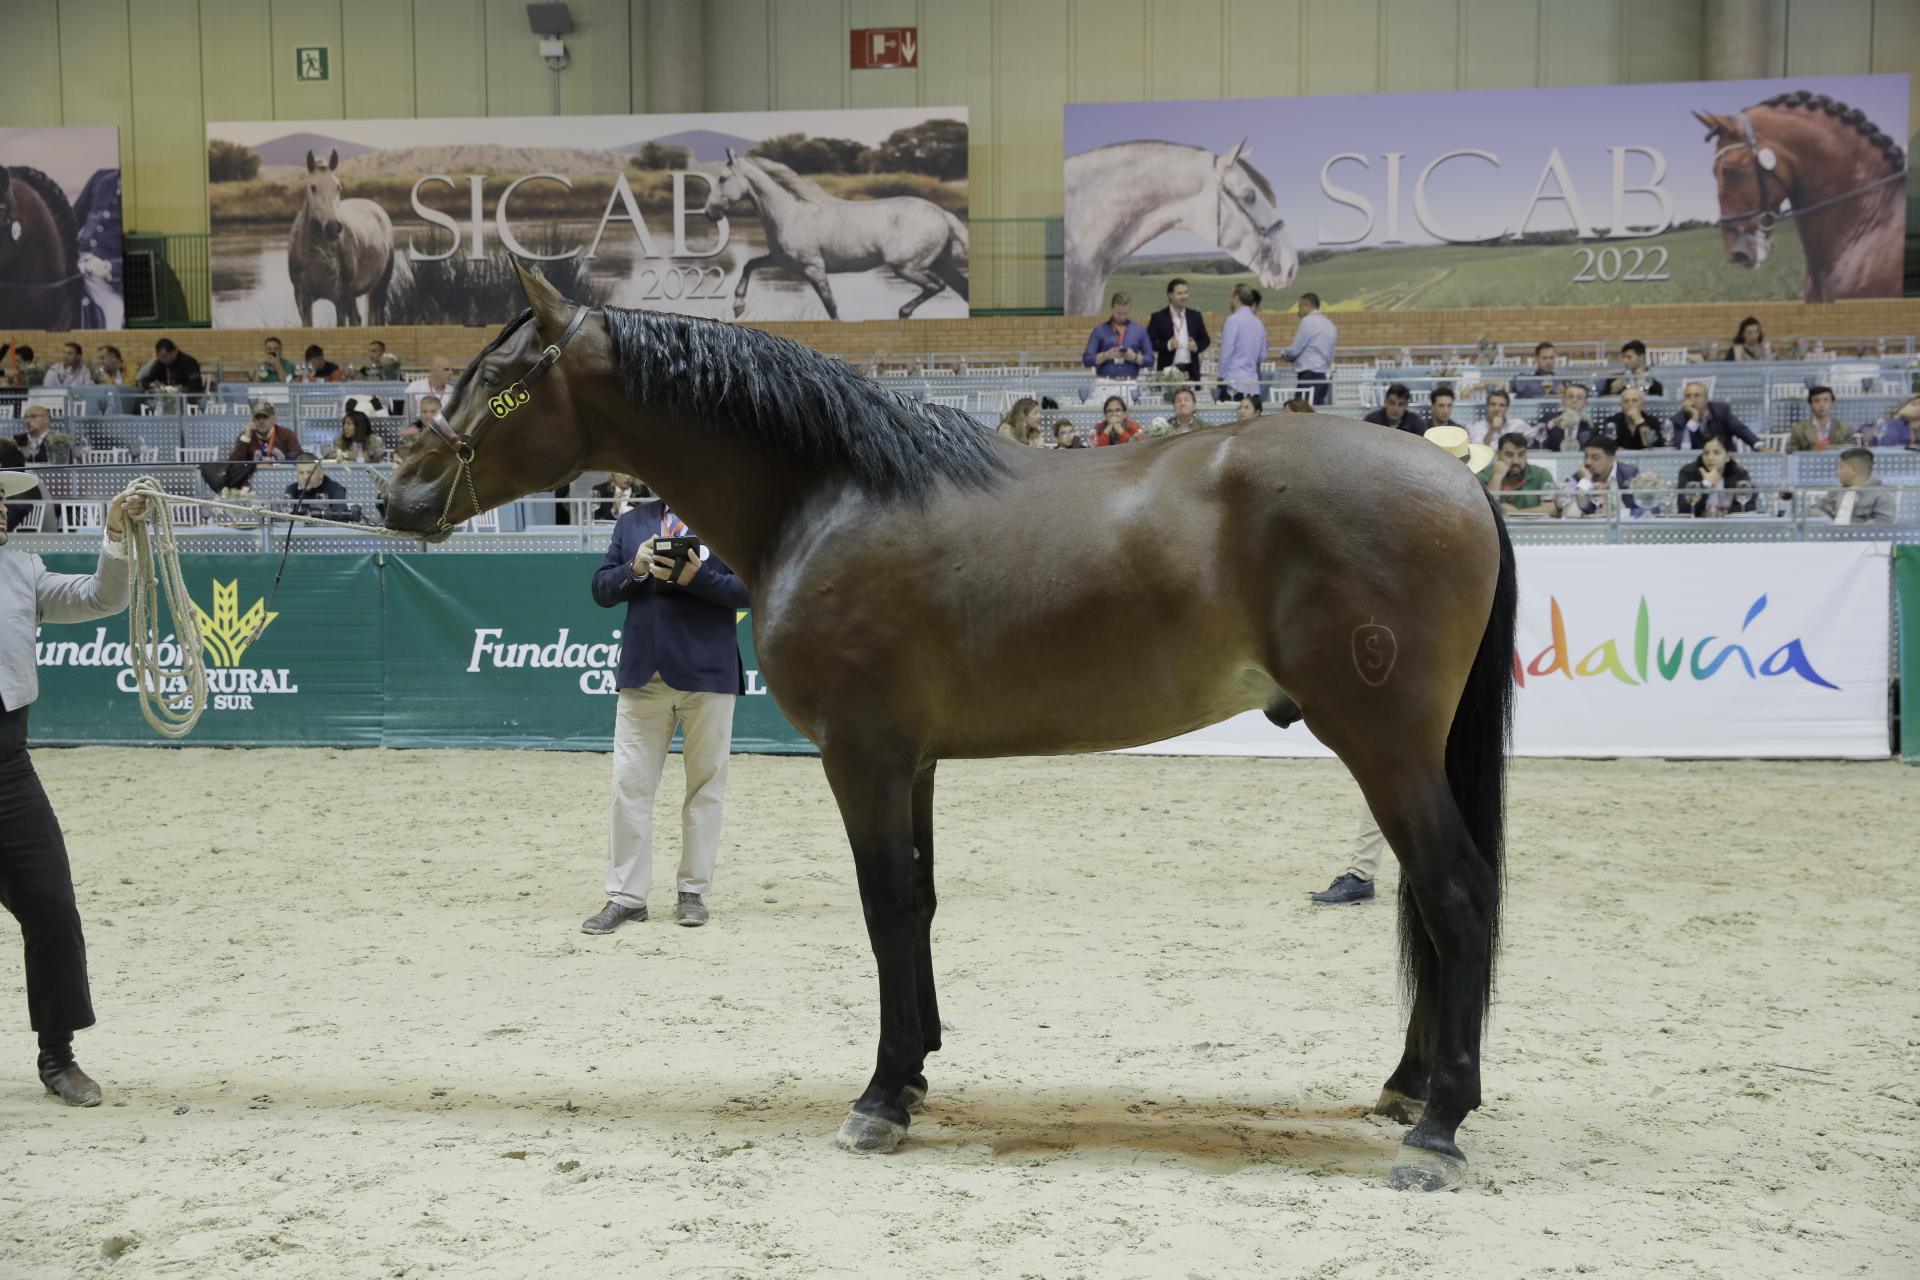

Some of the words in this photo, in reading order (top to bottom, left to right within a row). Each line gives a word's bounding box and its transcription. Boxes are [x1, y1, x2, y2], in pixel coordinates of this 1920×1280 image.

[1317, 146, 1675, 245] SICAB
[409, 172, 730, 261] SICAB
[641, 266, 728, 300] 2022
[1572, 246, 1671, 283] 2022
[466, 628, 622, 673] Fundaci
[205, 668, 299, 693] RURAL
[168, 694, 208, 710] DE
[213, 694, 255, 710] SUR
